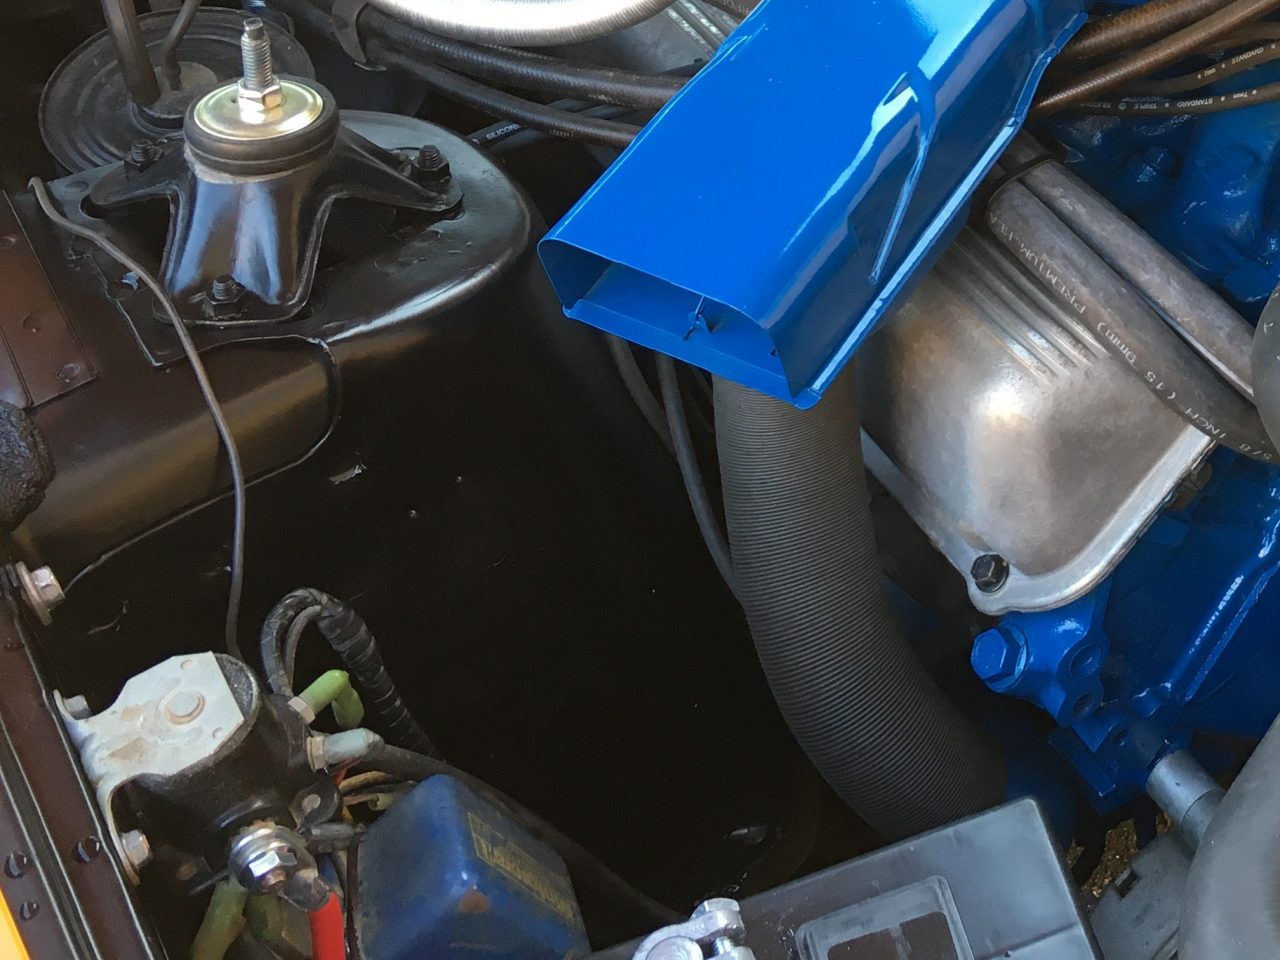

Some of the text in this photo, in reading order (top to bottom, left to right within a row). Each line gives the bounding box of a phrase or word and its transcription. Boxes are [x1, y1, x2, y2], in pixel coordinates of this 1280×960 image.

[1231, 46, 1264, 64] STANDARD
[1177, 98, 1213, 108] STANDARD
[1232, 90, 1249, 99] 7mm
[1020, 242, 1086, 314] PREMIUM
[1184, 407, 1227, 440] INCH
